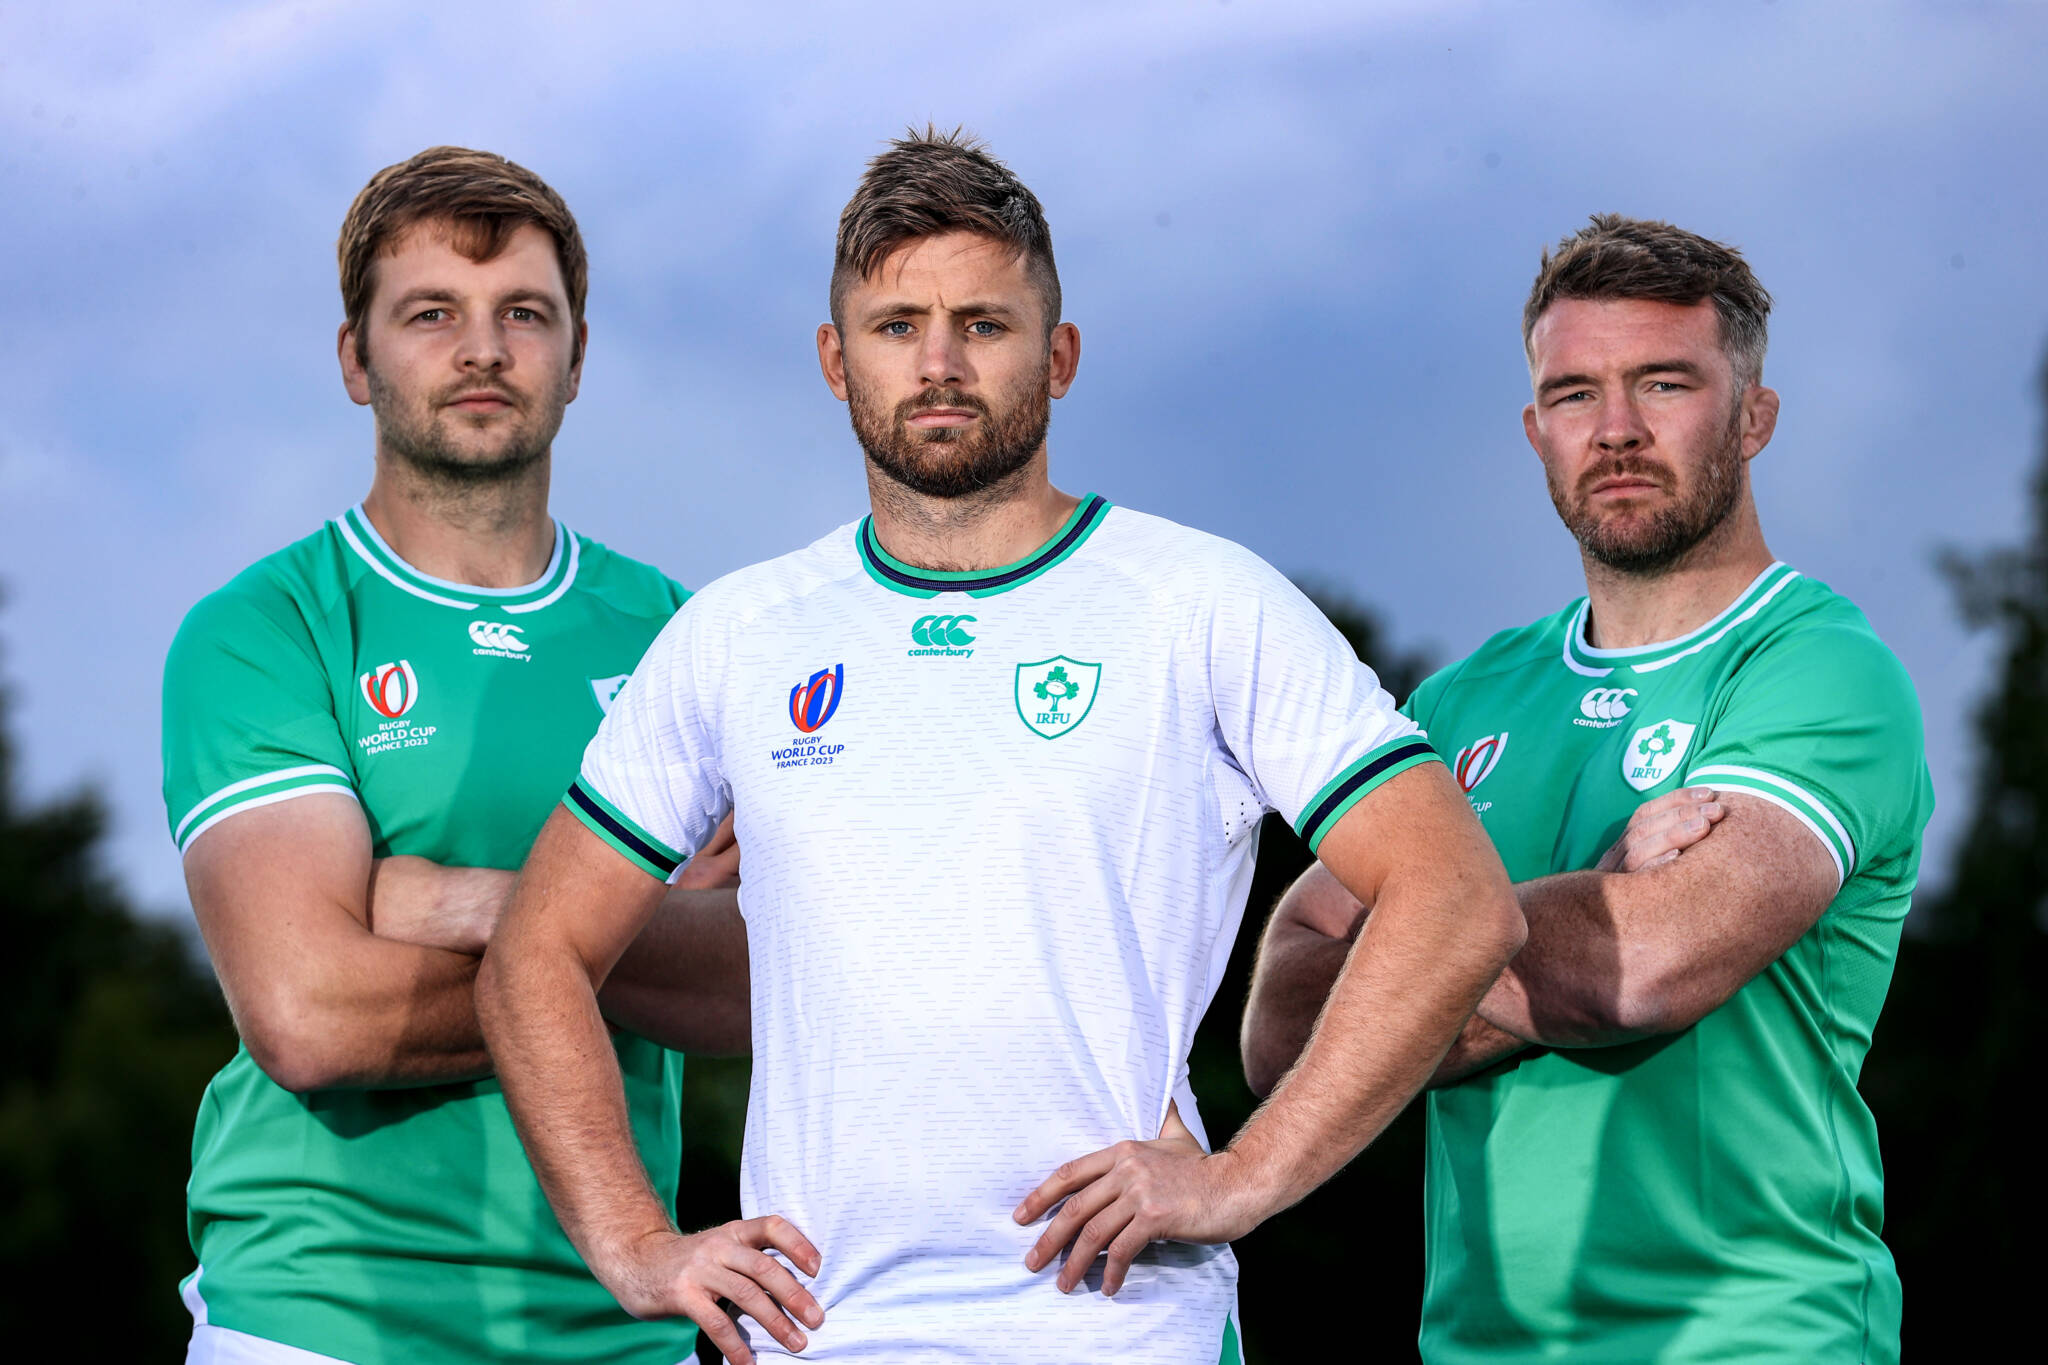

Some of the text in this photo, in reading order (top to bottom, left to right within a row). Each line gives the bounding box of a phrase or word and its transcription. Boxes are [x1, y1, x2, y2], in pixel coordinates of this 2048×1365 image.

[472, 648, 532, 663] canterbury
[907, 646, 974, 659] canterbury
[1033, 712, 1071, 724] IRFU
[378, 720, 411, 731] RUGBY
[358, 726, 437, 748] WORLD CUP
[793, 736, 823, 746] RUGBY
[366, 737, 429, 756] FRANCE 2023
[771, 744, 845, 761] WORLD CUP
[776, 756, 834, 769] FRANCE 2023
[1631, 767, 1663, 779] IRFU
